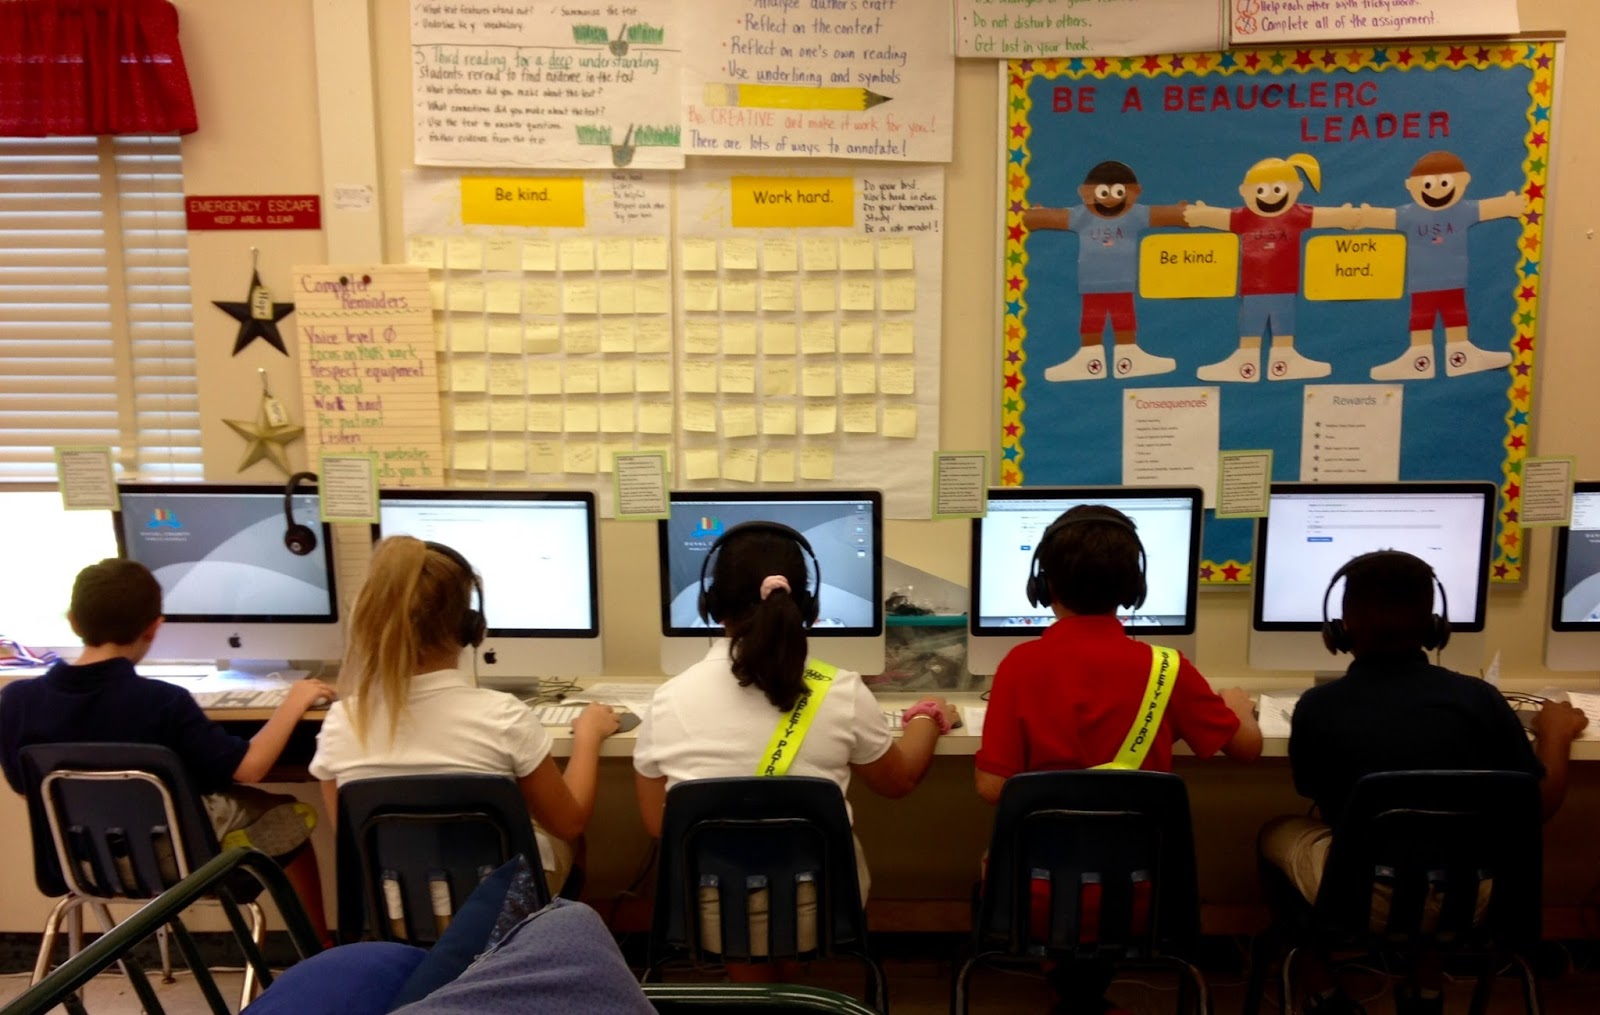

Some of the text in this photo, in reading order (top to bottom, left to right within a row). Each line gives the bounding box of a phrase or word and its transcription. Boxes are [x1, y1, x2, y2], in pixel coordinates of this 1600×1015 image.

[1283, 0, 1303, 10] each
[744, 13, 883, 35] Reflect on the content
[973, 11, 986, 28] Do
[992, 13, 1009, 28] not
[1014, 14, 1052, 29] disturb
[1261, 17, 1308, 34] Complete
[1315, 16, 1329, 29] all
[1335, 15, 1346, 29] of
[1350, 13, 1367, 27] the
[731, 36, 907, 68] Reflect on one's own reading
[975, 34, 997, 52] Get
[1002, 36, 1020, 52] lost
[1023, 40, 1033, 53] in
[1037, 42, 1060, 56] your
[464, 50, 507, 72] reading
[535, 56, 543, 66] a
[549, 50, 574, 71] deep
[579, 51, 660, 75] understanding
[520, 67, 541, 82] find
[728, 60, 902, 88] Use underlining and symbols
[1051, 80, 1379, 113] BE A BEAUCLERC
[710, 107, 775, 127] CREATIVE
[785, 112, 803, 129] and
[808, 113, 835, 130] make
[840, 113, 850, 131] it
[854, 115, 878, 131] work
[1299, 111, 1450, 143] LEADER
[689, 129, 907, 157] There are lots of ways to annotate!
[495, 187, 512, 201] Be
[863, 179, 875, 191] Do
[752, 188, 834, 204] Work hard.
[190, 200, 314, 213] EMERGENCY ESCAPE
[214, 215, 294, 224] KEEP AREA CLEAR
[1336, 239, 1378, 253] Work
[1160, 250, 1218, 264] Be kind.
[1335, 263, 1374, 278] hard.
[342, 291, 408, 309] Reminders
[304, 325, 375, 344] Voice level
[309, 360, 358, 382] Respect
[366, 359, 424, 383] equipment
[312, 395, 382, 411] Work hard
[1135, 399, 1208, 411] Consequences
[1332, 395, 1377, 406] Rewards
[319, 427, 362, 445] Listen
[1130, 651, 1169, 752] SAFETY PATROL
[764, 739, 788, 777] PATR
